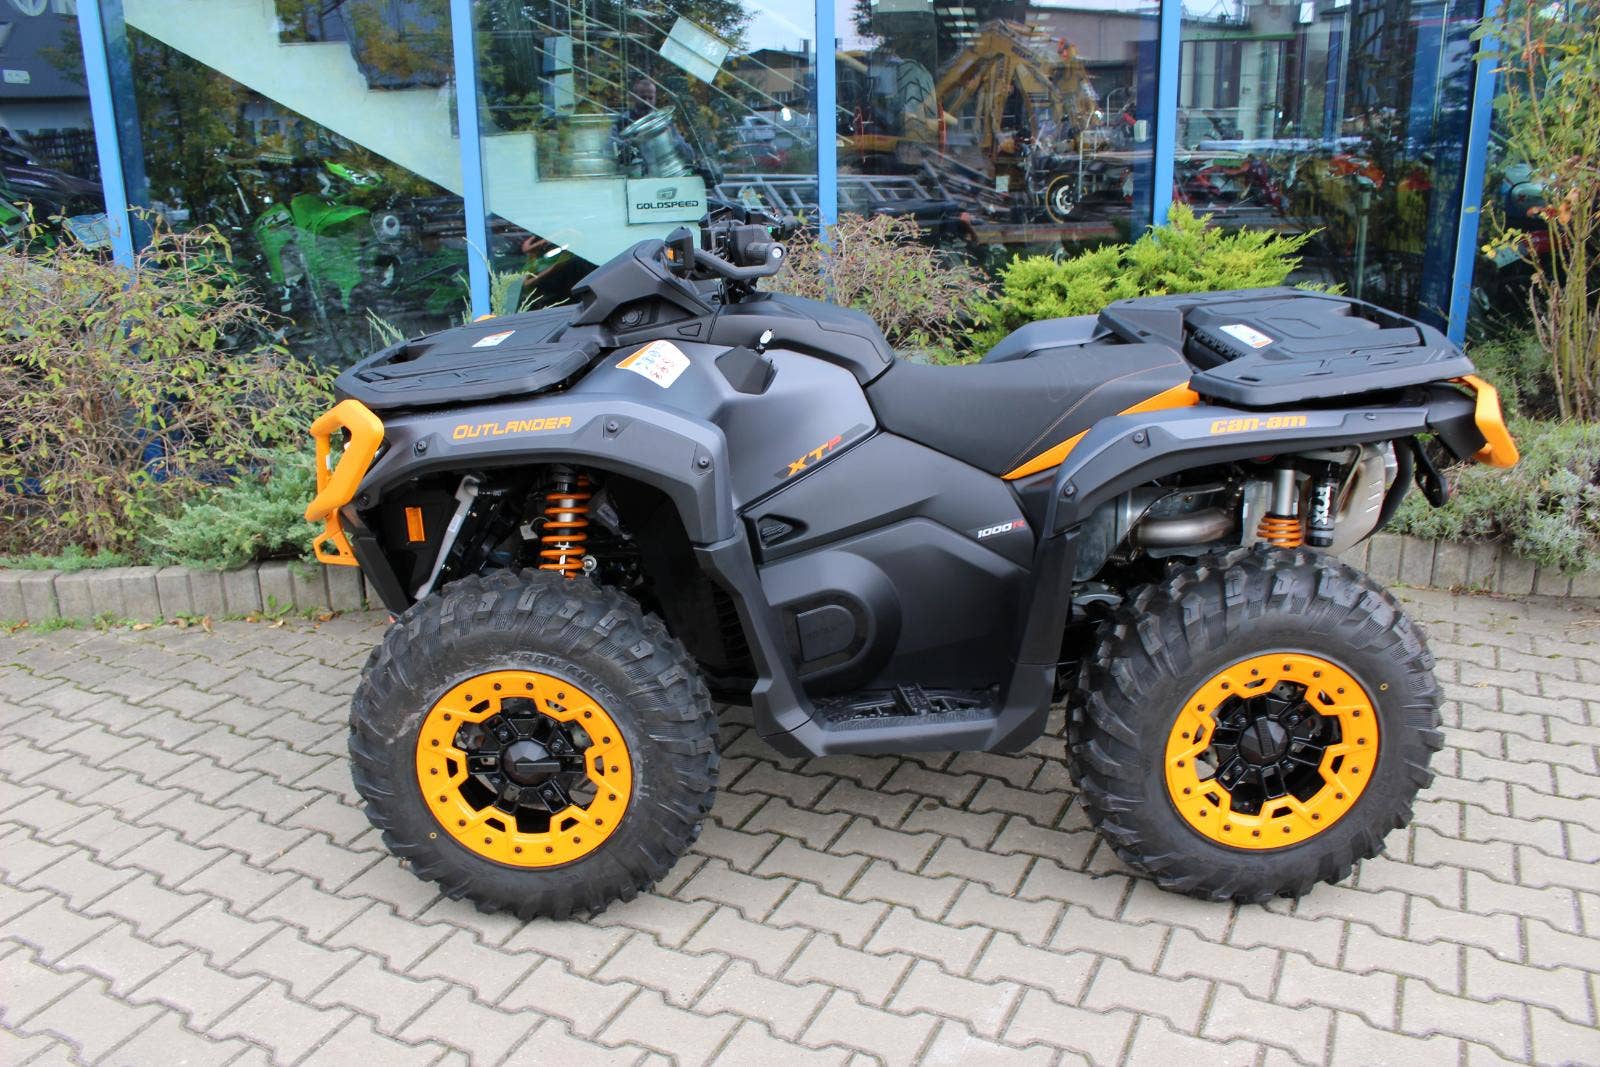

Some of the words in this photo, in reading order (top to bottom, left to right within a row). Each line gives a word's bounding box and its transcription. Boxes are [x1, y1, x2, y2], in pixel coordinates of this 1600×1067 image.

[636, 200, 699, 210] GOLDSPEED
[452, 416, 573, 440] OUTLANDER
[977, 520, 1025, 538] 1000R
